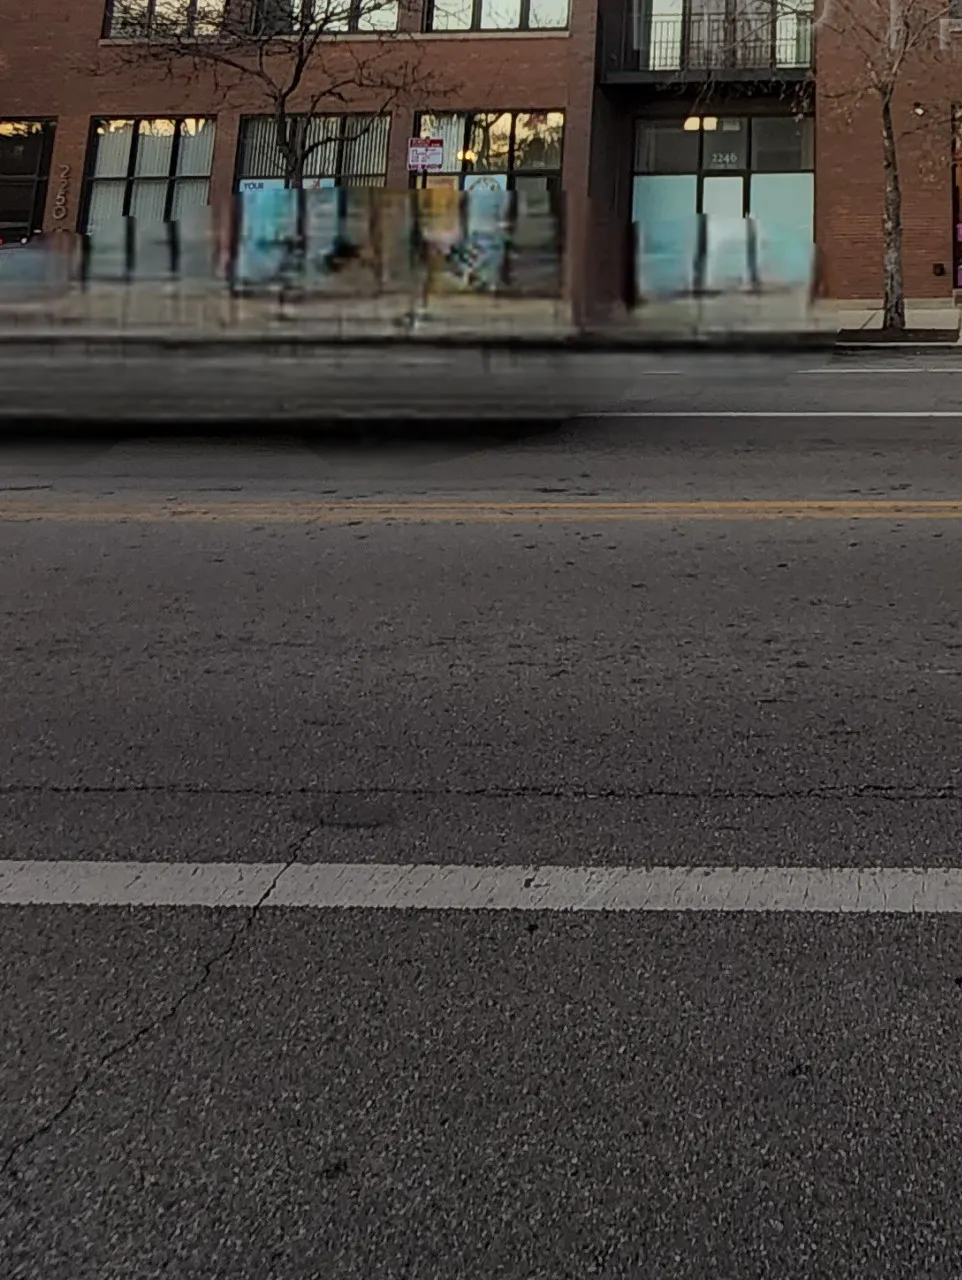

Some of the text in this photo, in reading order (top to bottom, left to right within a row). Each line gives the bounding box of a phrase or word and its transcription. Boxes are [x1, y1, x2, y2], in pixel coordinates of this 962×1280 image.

[712, 153, 738, 163] 2246
[243, 182, 264, 190] YOUR
[52, 164, 70, 220] 2250
